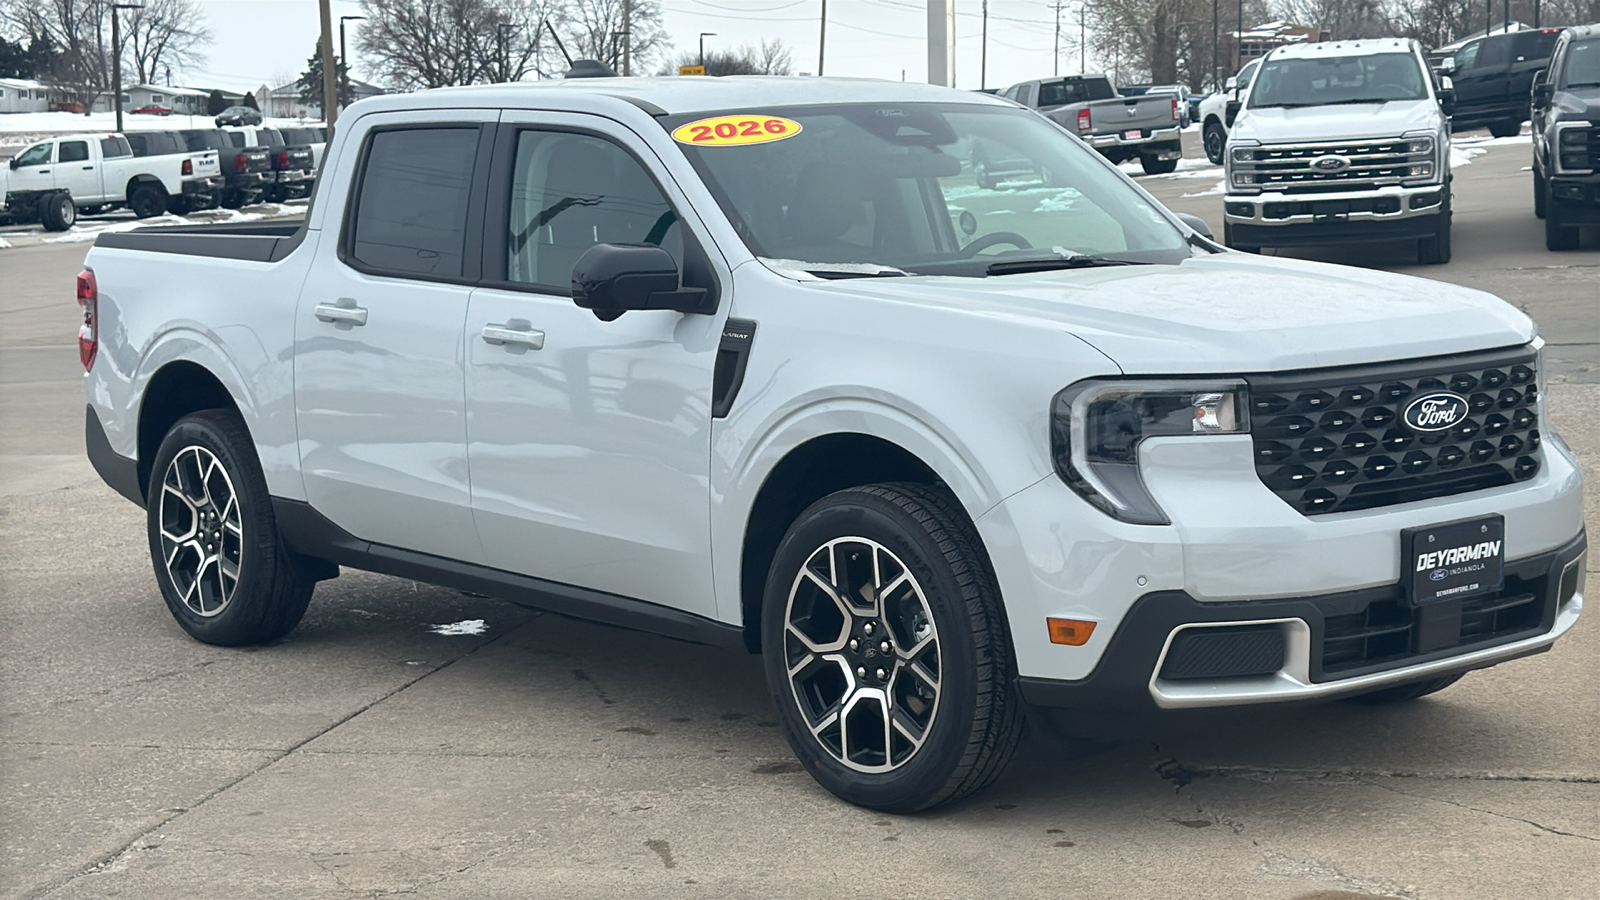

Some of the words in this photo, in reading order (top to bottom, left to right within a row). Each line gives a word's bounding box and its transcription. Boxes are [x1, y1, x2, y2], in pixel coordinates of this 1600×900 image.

[690, 119, 788, 142] 2026
[1417, 399, 1457, 426] Ford
[1416, 540, 1501, 572] DEYARMAN
[1449, 563, 1485, 575] INDIANOLA
